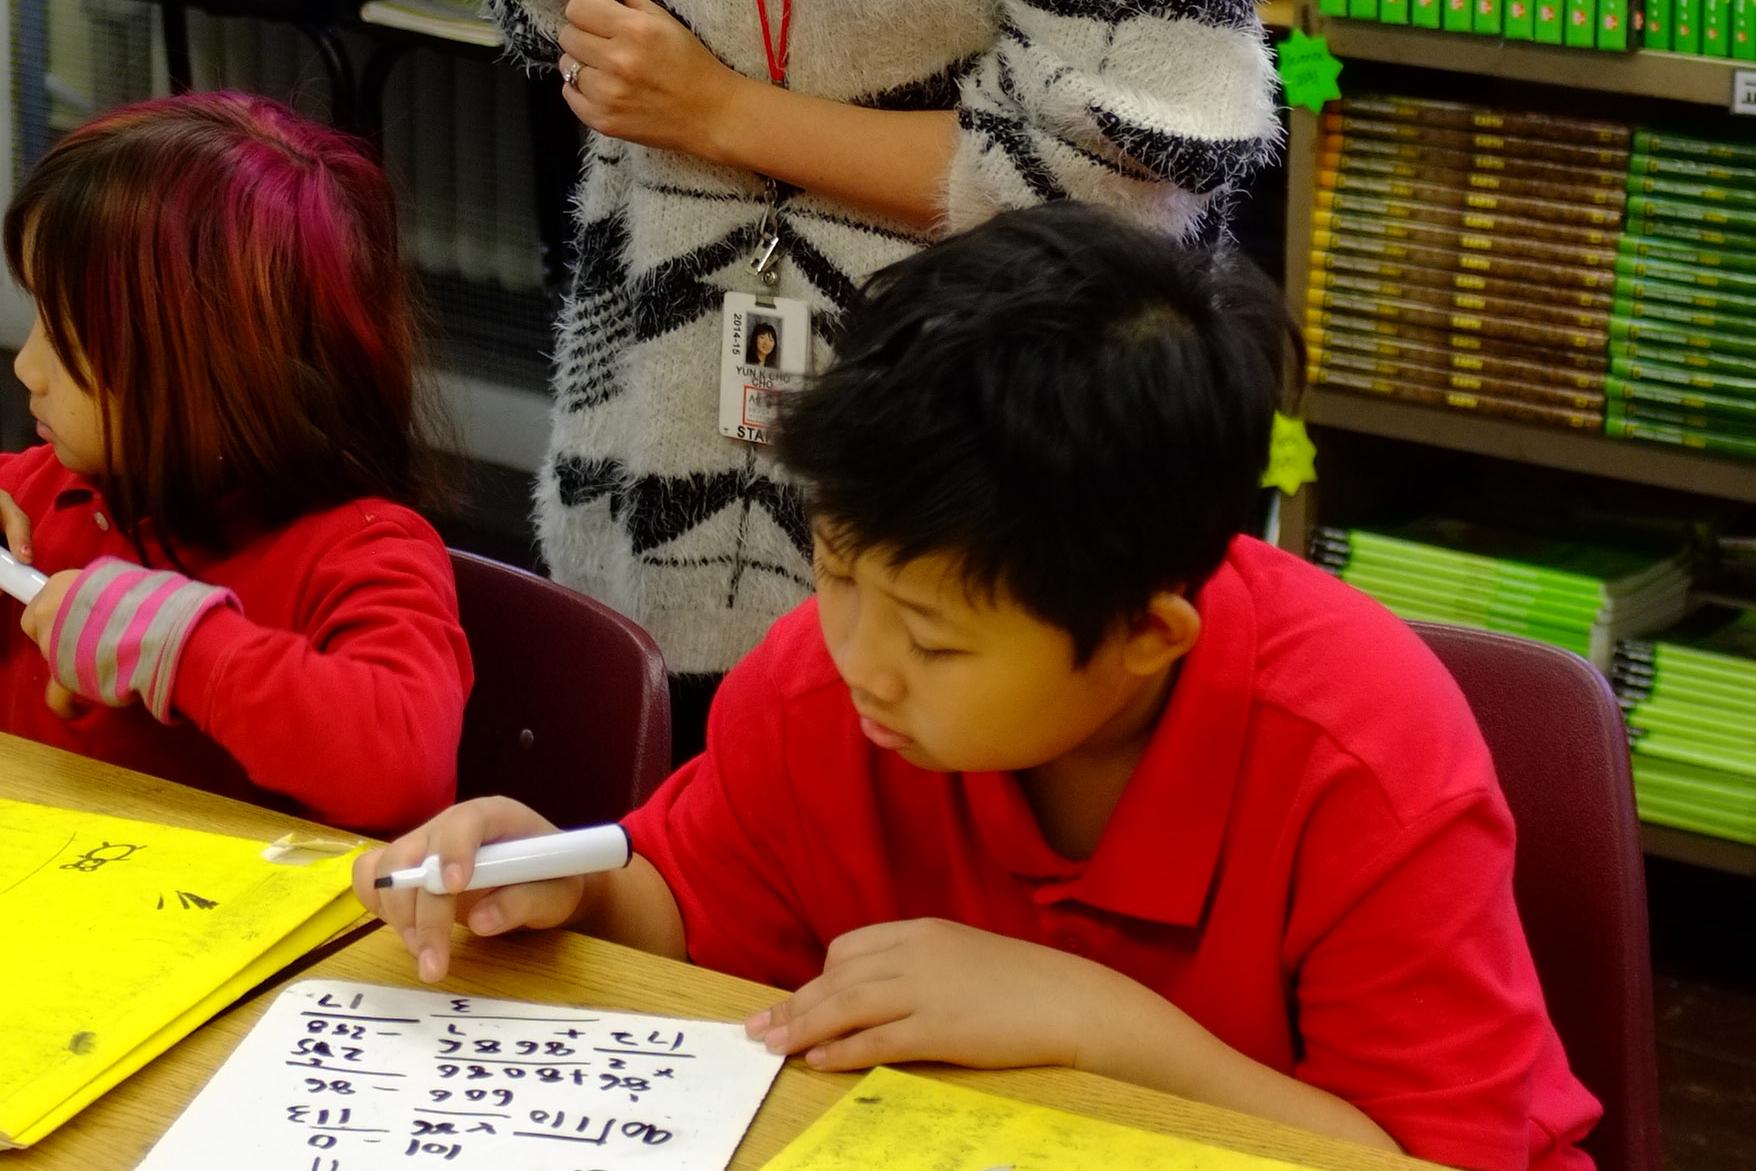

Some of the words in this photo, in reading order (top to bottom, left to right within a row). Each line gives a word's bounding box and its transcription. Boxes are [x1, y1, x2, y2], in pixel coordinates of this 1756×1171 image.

[731, 313, 743, 356] 2014-15
[736, 365, 756, 378] YUN
[759, 370, 766, 379] K
[769, 372, 791, 384] CHO
[751, 377, 774, 389] CHO
[737, 425, 769, 443] STA
[304, 1078, 356, 1096] 86
[286, 1105, 351, 1125] 113
[404, 1139, 462, 1160] 101
